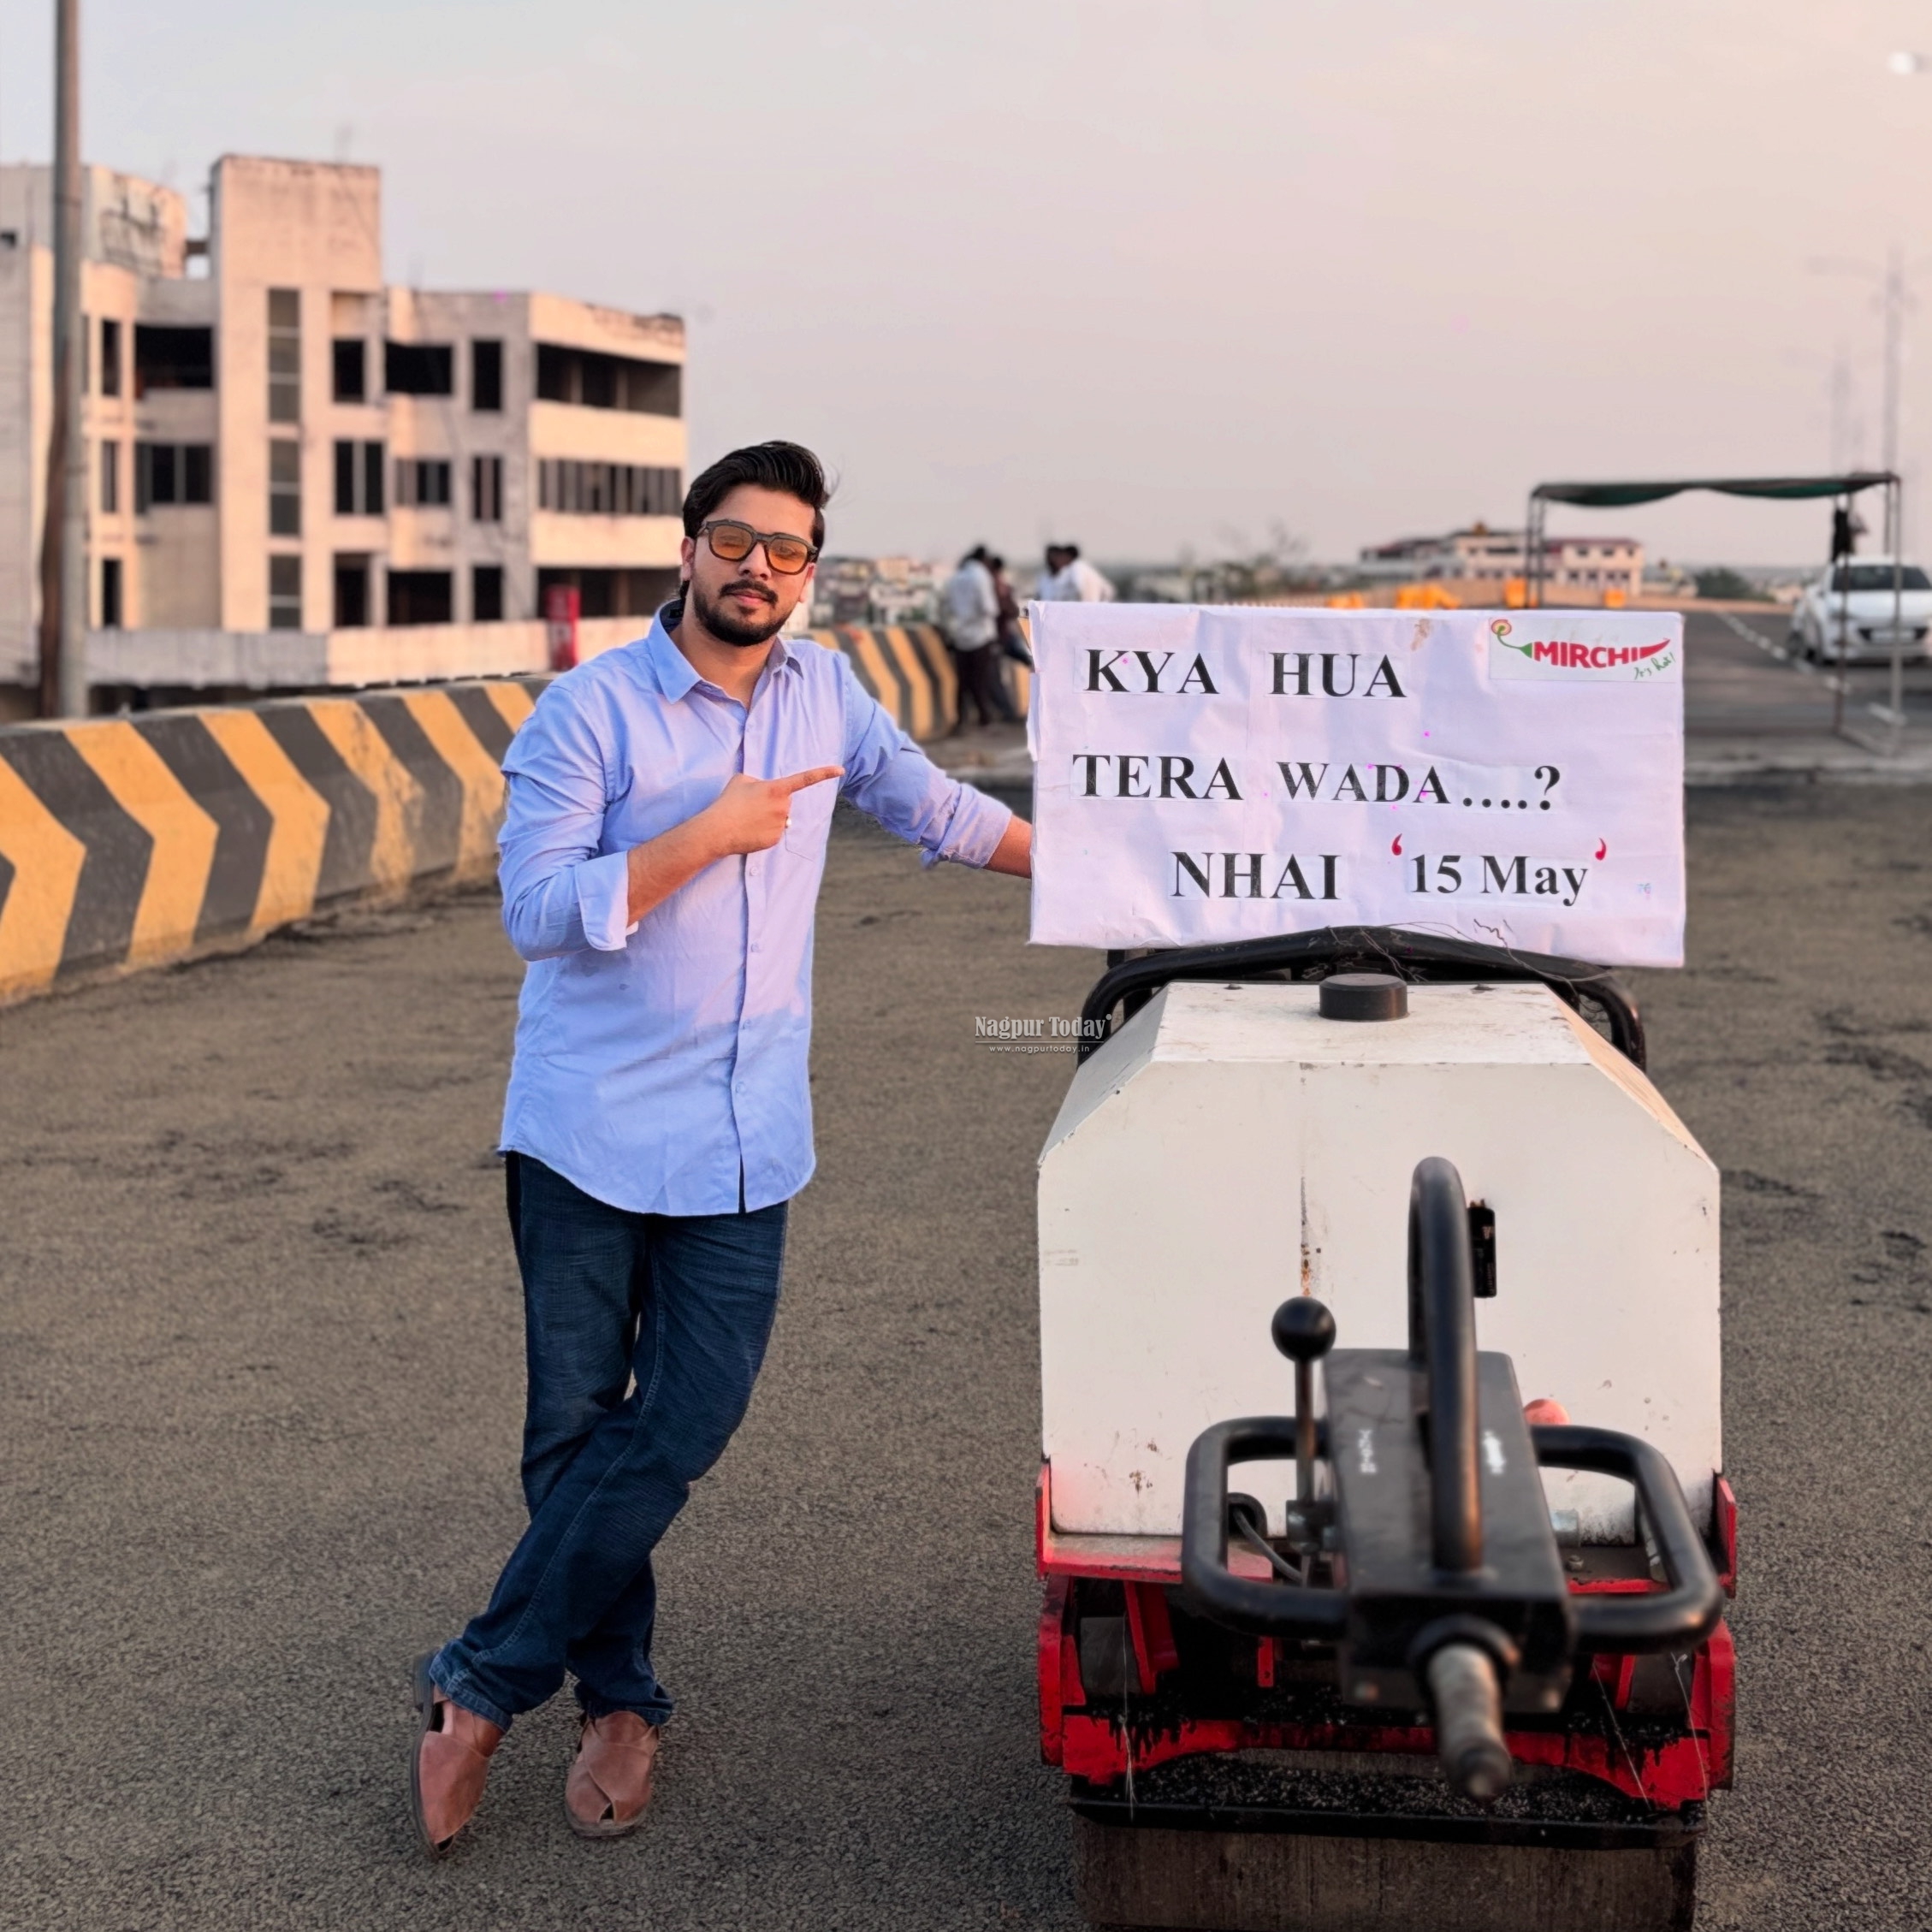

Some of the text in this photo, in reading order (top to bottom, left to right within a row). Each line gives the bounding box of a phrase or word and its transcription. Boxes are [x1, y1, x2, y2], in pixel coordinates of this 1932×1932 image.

[1085, 649, 1407, 698] KYA HUA
[1533, 641, 1639, 669] MIRCHI
[1073, 754, 1244, 801] TERA
[1170, 851, 1341, 900] NHAI
